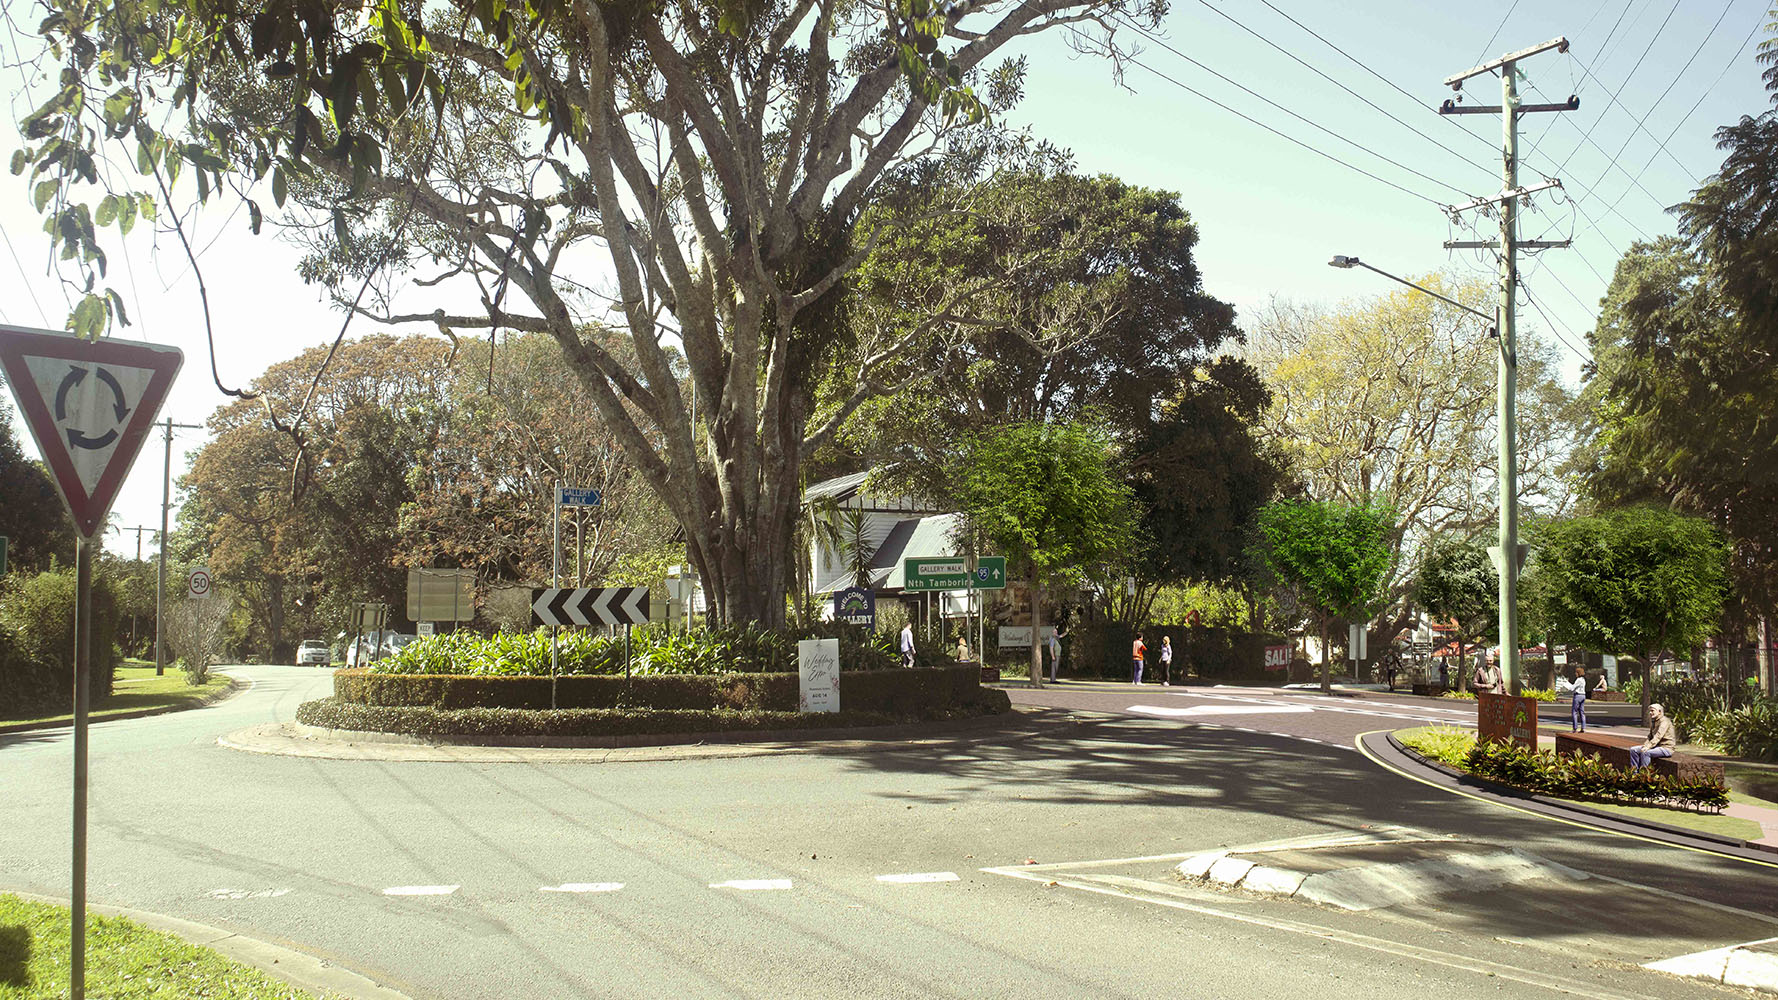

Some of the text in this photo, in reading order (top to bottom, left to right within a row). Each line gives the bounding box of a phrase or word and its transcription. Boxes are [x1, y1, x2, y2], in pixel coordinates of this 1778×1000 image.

[563, 489, 591, 497] GALLERY
[569, 496, 587, 504] WALK
[979, 568, 987, 577] 95
[193, 578, 207, 588] 50
[908, 579, 924, 588] Nth
[840, 591, 869, 610] WELCOME TO
[838, 615, 872, 624] ALLERY
